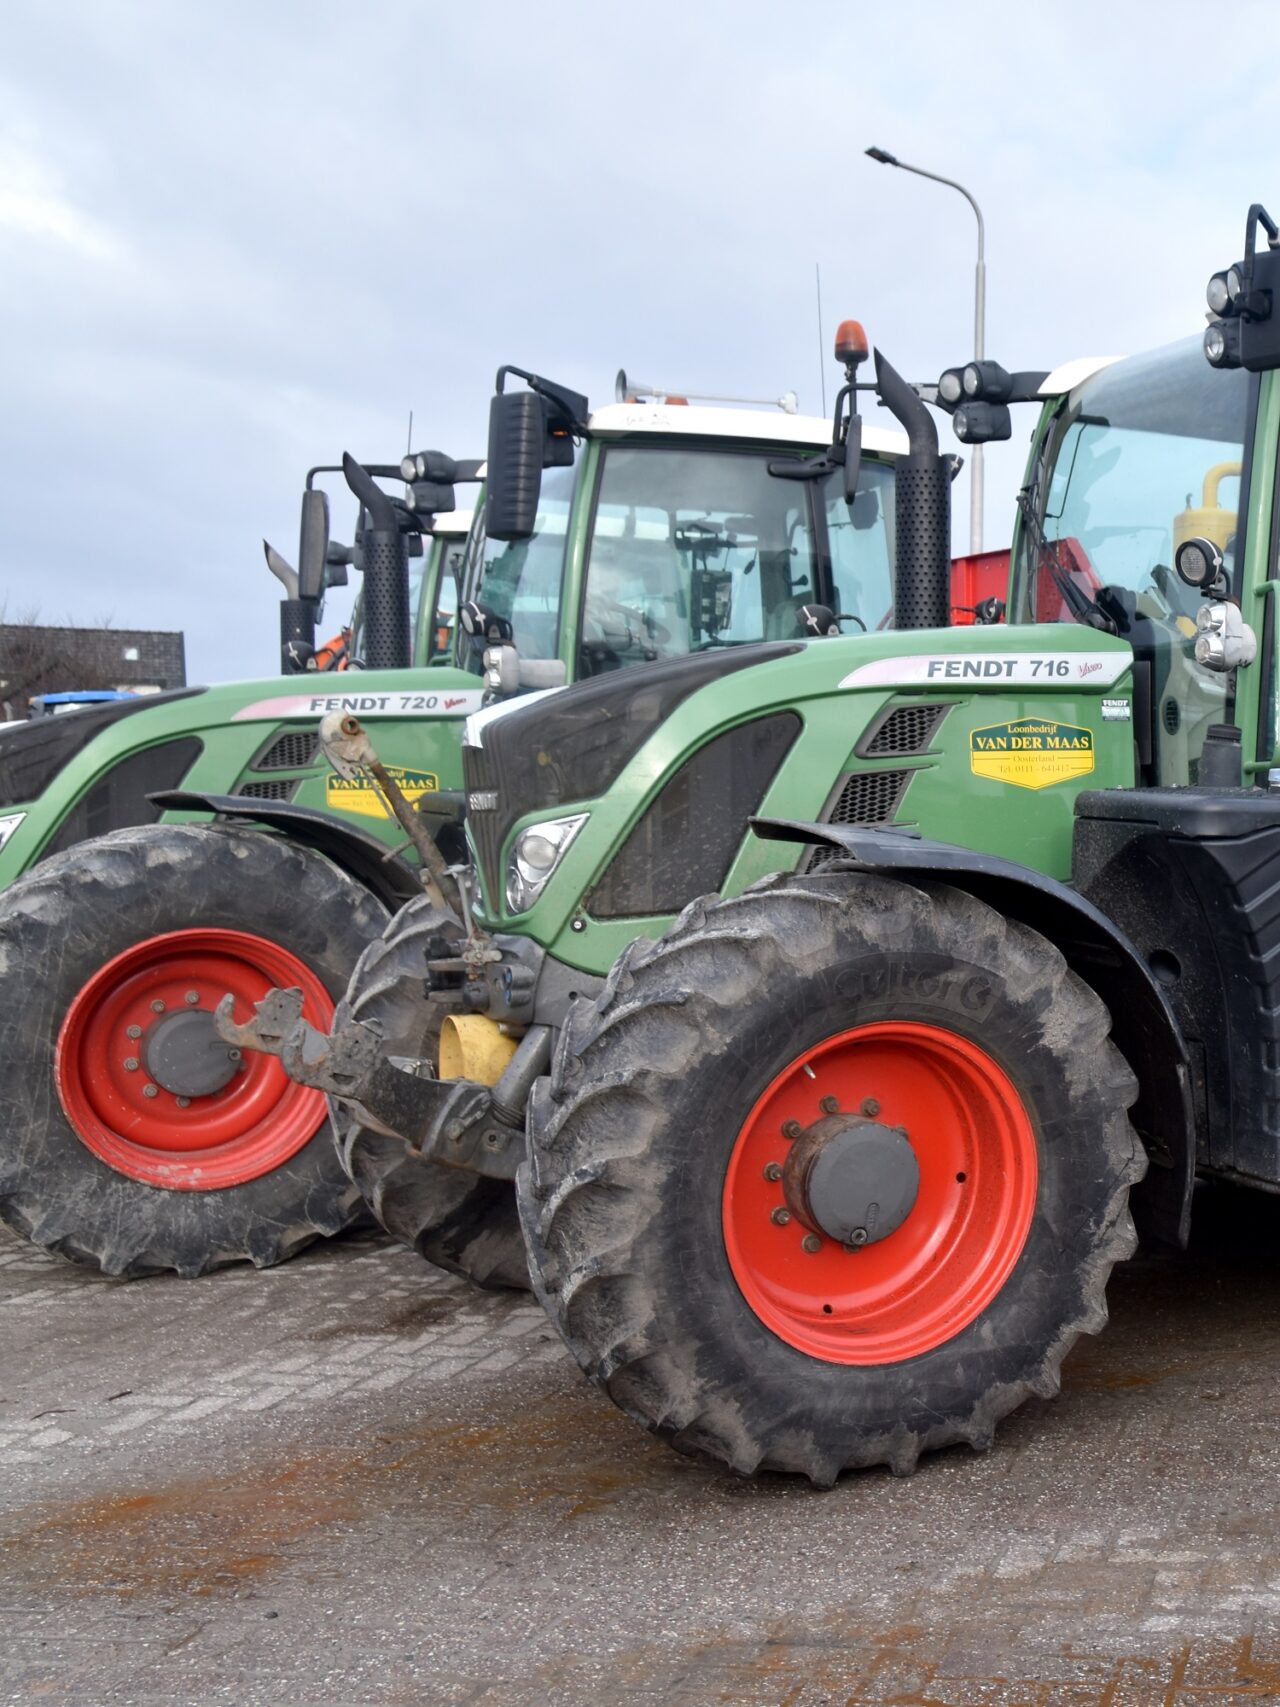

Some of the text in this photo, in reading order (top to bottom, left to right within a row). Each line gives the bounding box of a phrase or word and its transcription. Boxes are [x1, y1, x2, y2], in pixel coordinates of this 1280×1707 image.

[928, 660, 1018, 678] FENDT
[1030, 660, 1070, 677] 716
[310, 698, 390, 711] FENDT
[400, 696, 438, 709] 720
[1008, 725, 1058, 735] Loonbedrijf
[976, 737, 1089, 750] VAN DER MAAS
[332, 779, 360, 789] VAN
